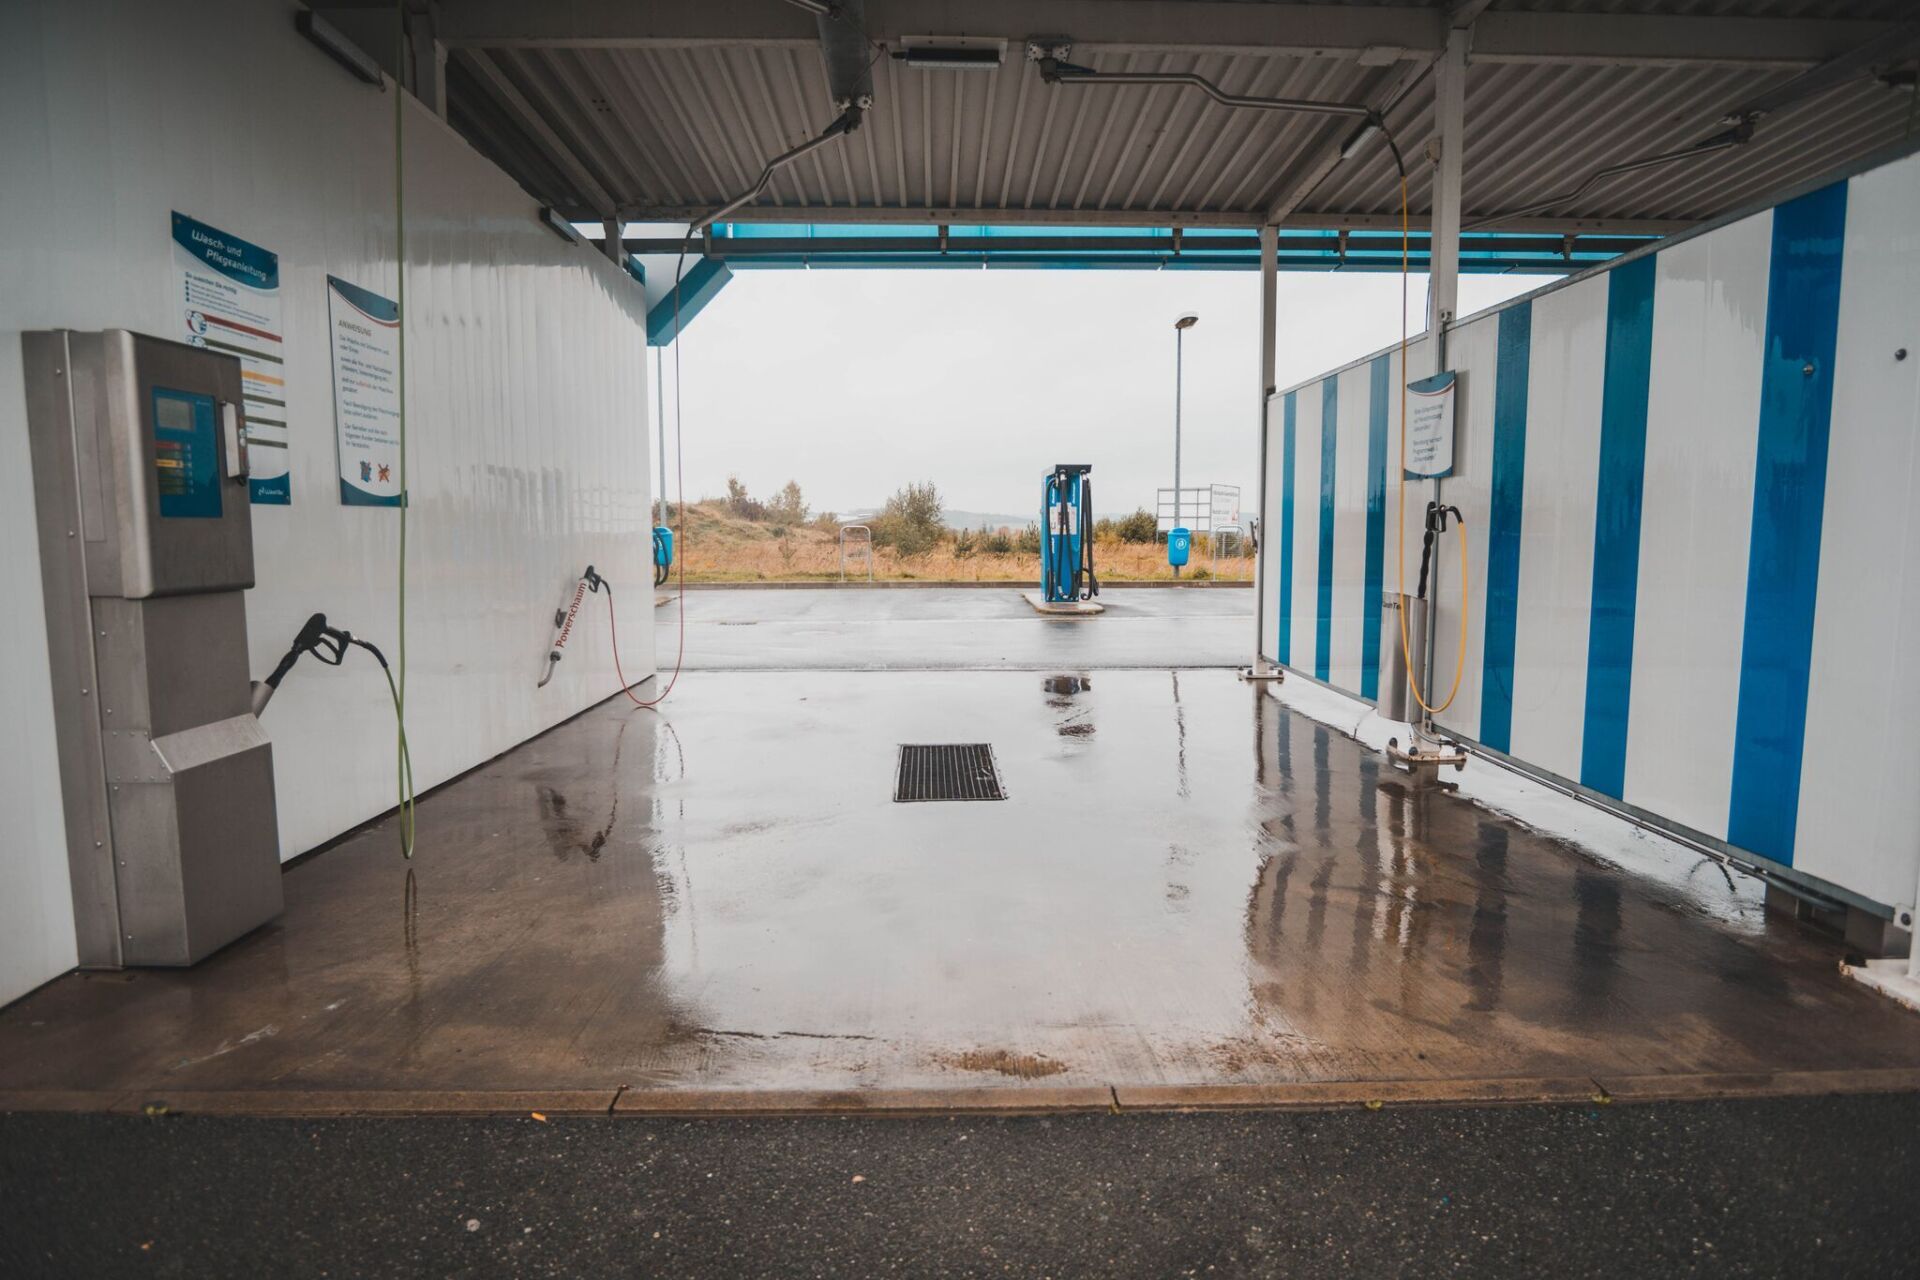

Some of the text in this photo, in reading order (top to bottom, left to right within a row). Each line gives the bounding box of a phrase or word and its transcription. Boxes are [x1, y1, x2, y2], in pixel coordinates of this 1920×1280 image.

[191, 229, 242, 257] Wasch- und
[206, 249, 267, 281] Pflegeanleitung
[338, 320, 372, 337] ANWEISUNG
[555, 582, 587, 649] Powerschaum
